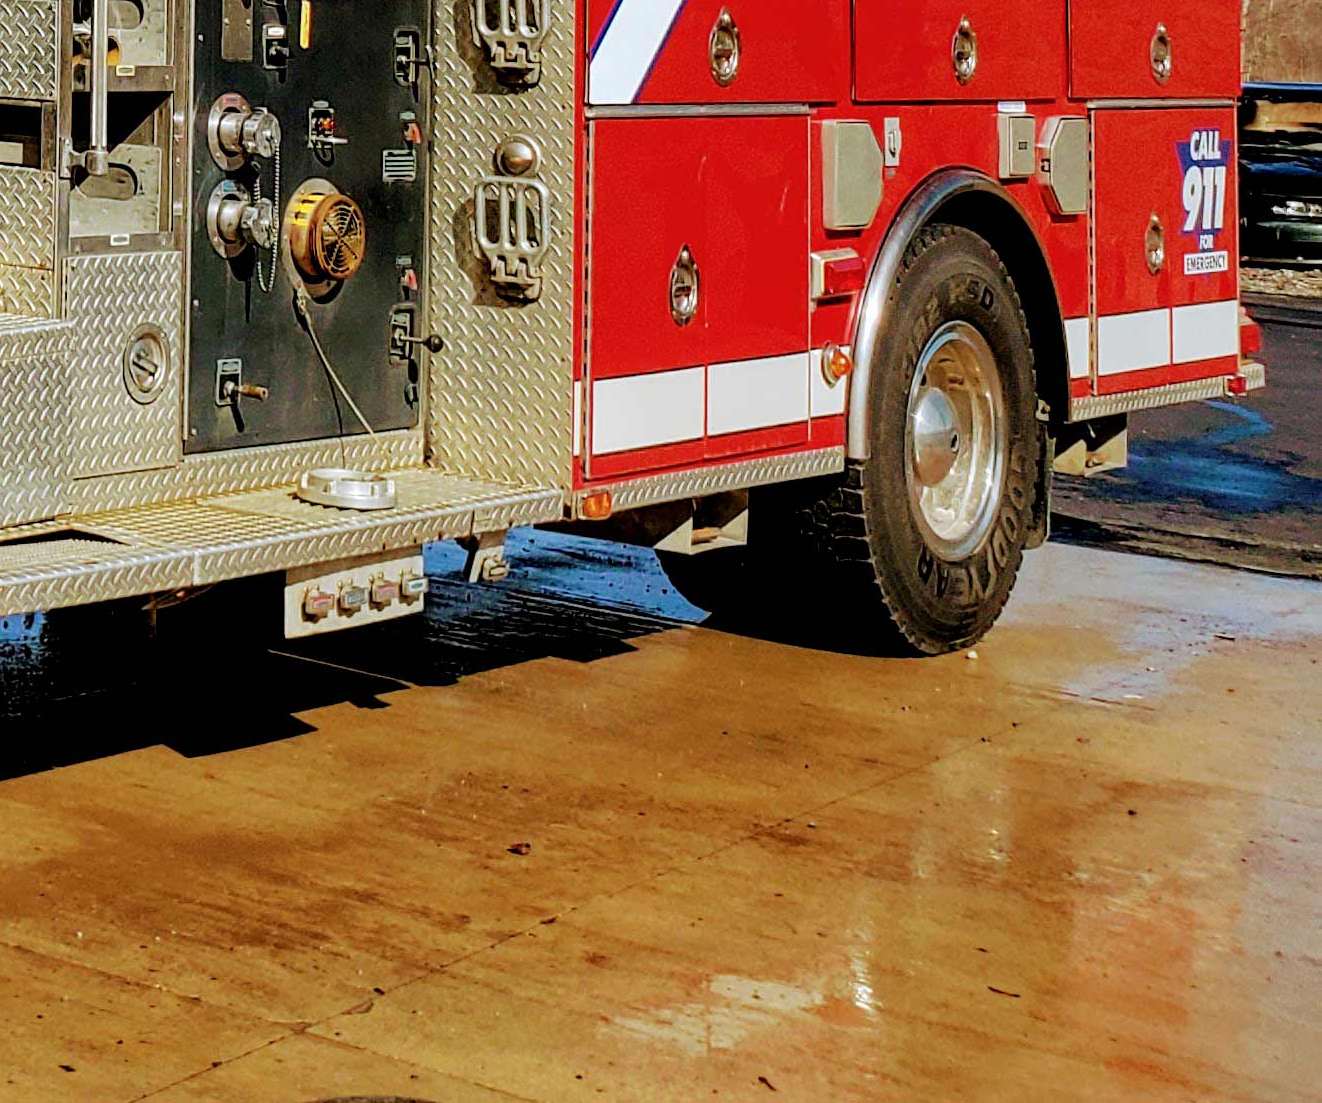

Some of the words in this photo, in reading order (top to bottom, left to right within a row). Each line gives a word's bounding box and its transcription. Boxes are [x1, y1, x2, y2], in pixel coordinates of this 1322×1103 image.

[1189, 130, 1222, 161] CALL
[1182, 165, 1227, 232] 911
[1199, 234, 1214, 250] FOR
[1186, 253, 1226, 272] EMERGENCY
